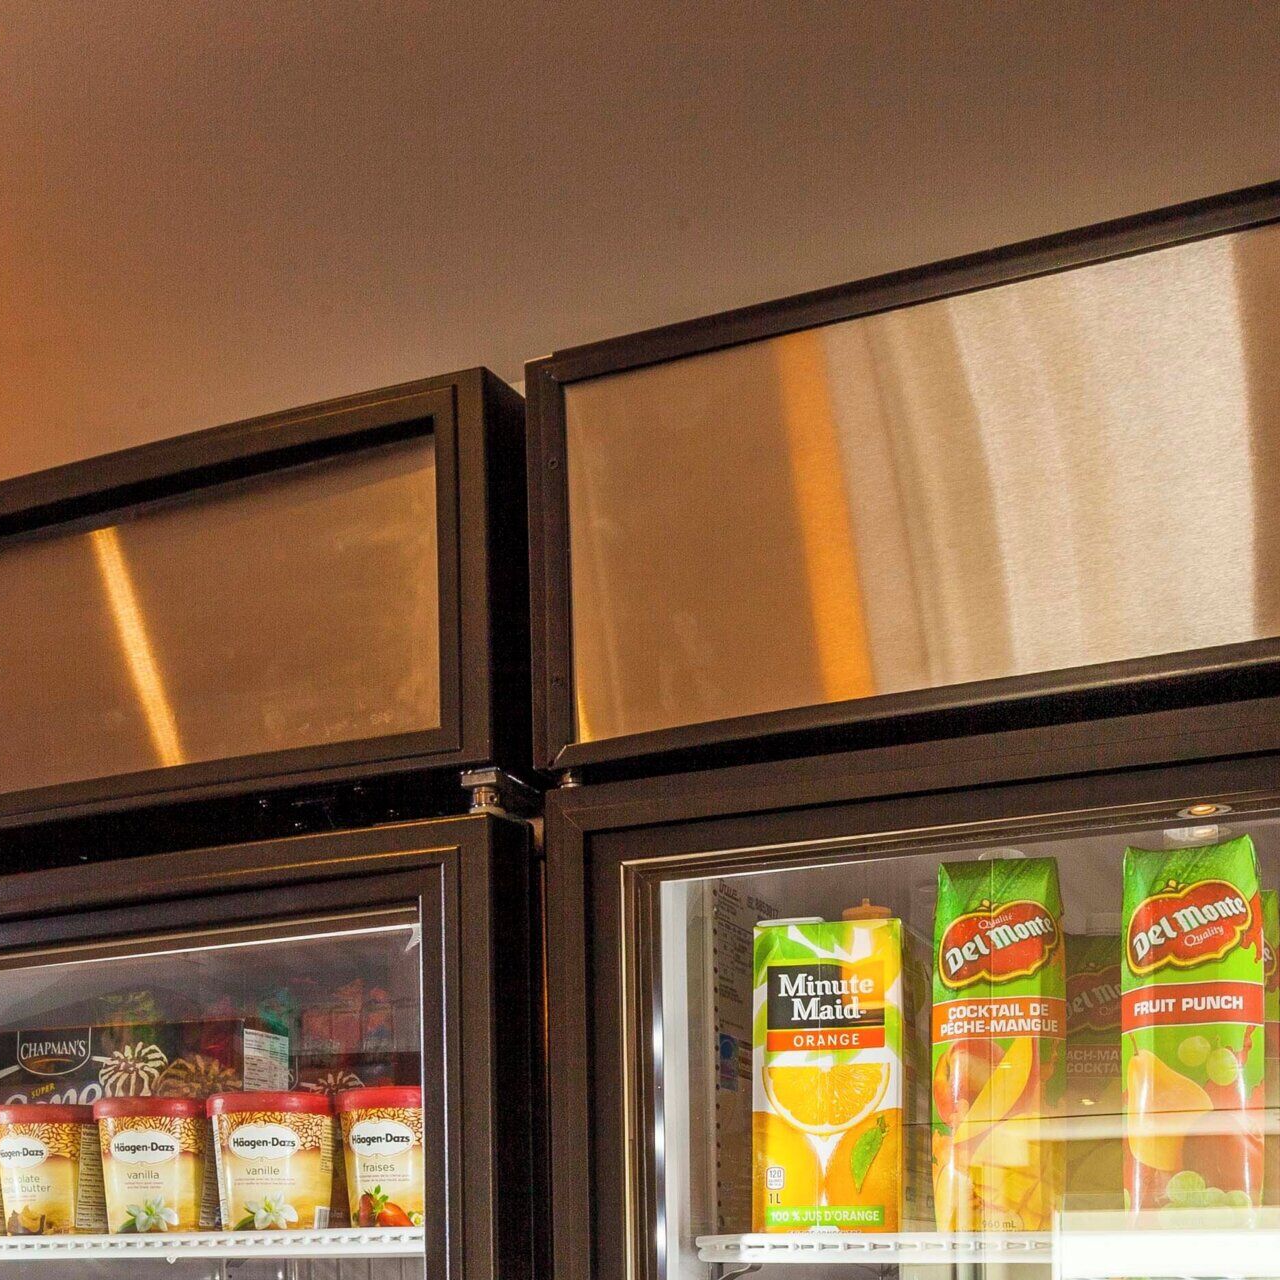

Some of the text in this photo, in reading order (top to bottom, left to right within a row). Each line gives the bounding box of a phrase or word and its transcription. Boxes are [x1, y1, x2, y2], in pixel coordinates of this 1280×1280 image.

[1133, 897, 1246, 962] Del Monte
[1184, 925, 1224, 947] Quality
[945, 916, 1054, 975] Del Monte
[778, 974, 874, 997] Minute
[791, 997, 861, 1020] Maid
[948, 1003, 1049, 1020] COCKTAIL DE
[1134, 999, 1176, 1016] FRUIT
[1182, 996, 1243, 1011] PUNCH
[793, 1033, 860, 1047] ORANGE
[20, 1039, 86, 1059] CHAPMAN'S
[30, 1083, 55, 1098] SUPER
[233, 1137, 296, 1149] Häagen-Dazs
[351, 1133, 410, 1145] Häagen-Dazs
[114, 1142, 175, 1153] Häagen-Dazs
[245, 1166, 280, 1176] vanille
[362, 1162, 395, 1172] fraises
[127, 1171, 160, 1180] vanilla
[770, 1170, 781, 1178] 120
[21, 1184, 51, 1193] butter
[776, 1194, 781, 1203] L
[771, 1210, 880, 1221] 100 JUS D'ORANGE
